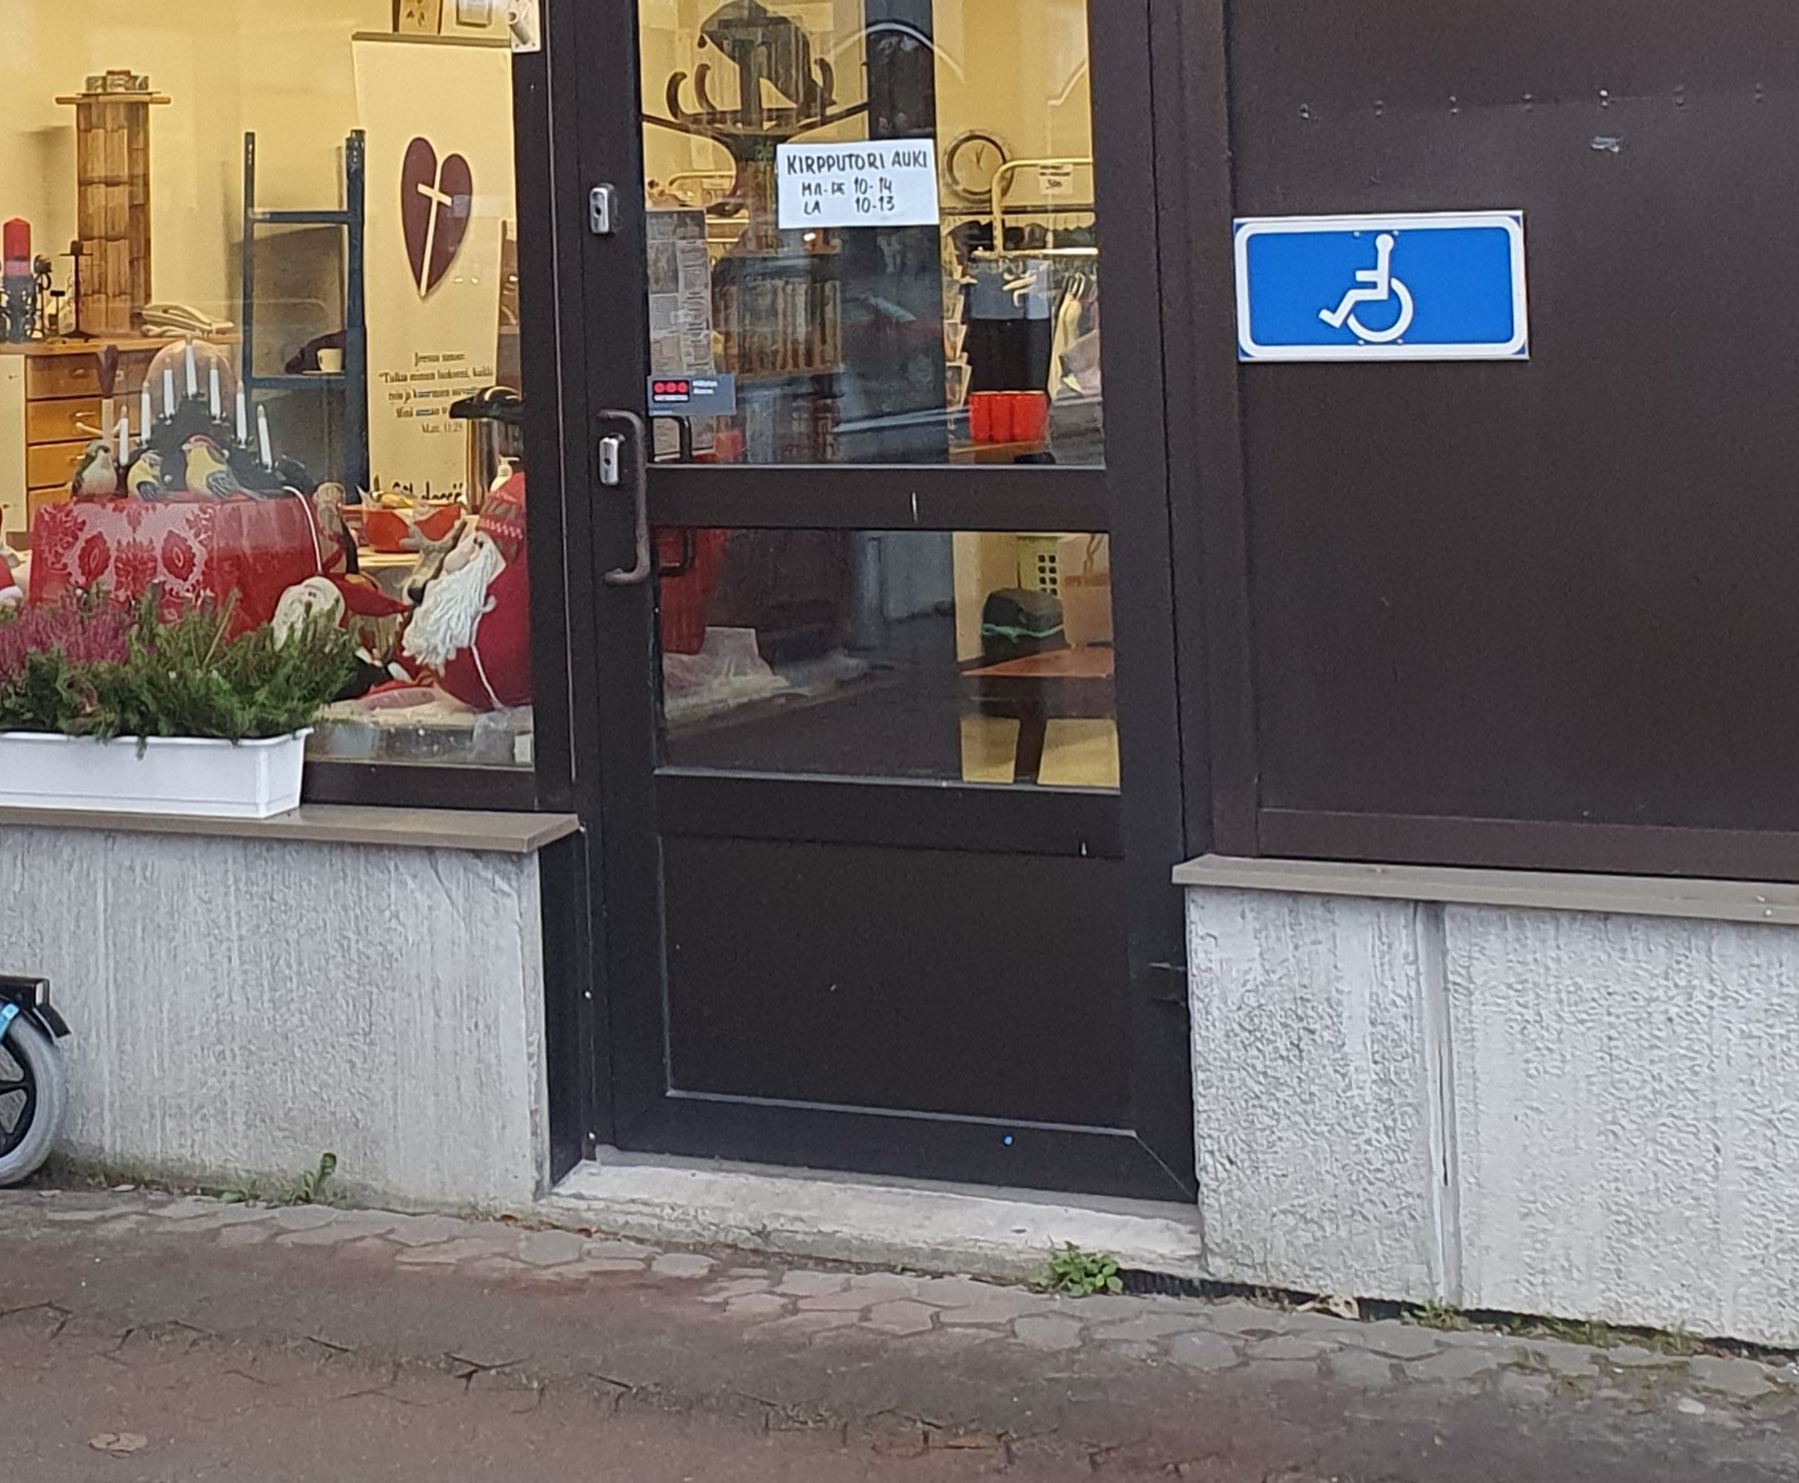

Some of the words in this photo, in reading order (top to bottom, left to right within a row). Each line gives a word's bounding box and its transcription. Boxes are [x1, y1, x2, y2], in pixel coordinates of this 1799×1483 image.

[786, 152, 886, 175] KIRPPUTORI
[891, 150, 928, 168] AUKI
[803, 199, 822, 215] LA
[855, 196, 895, 214] 10-13
